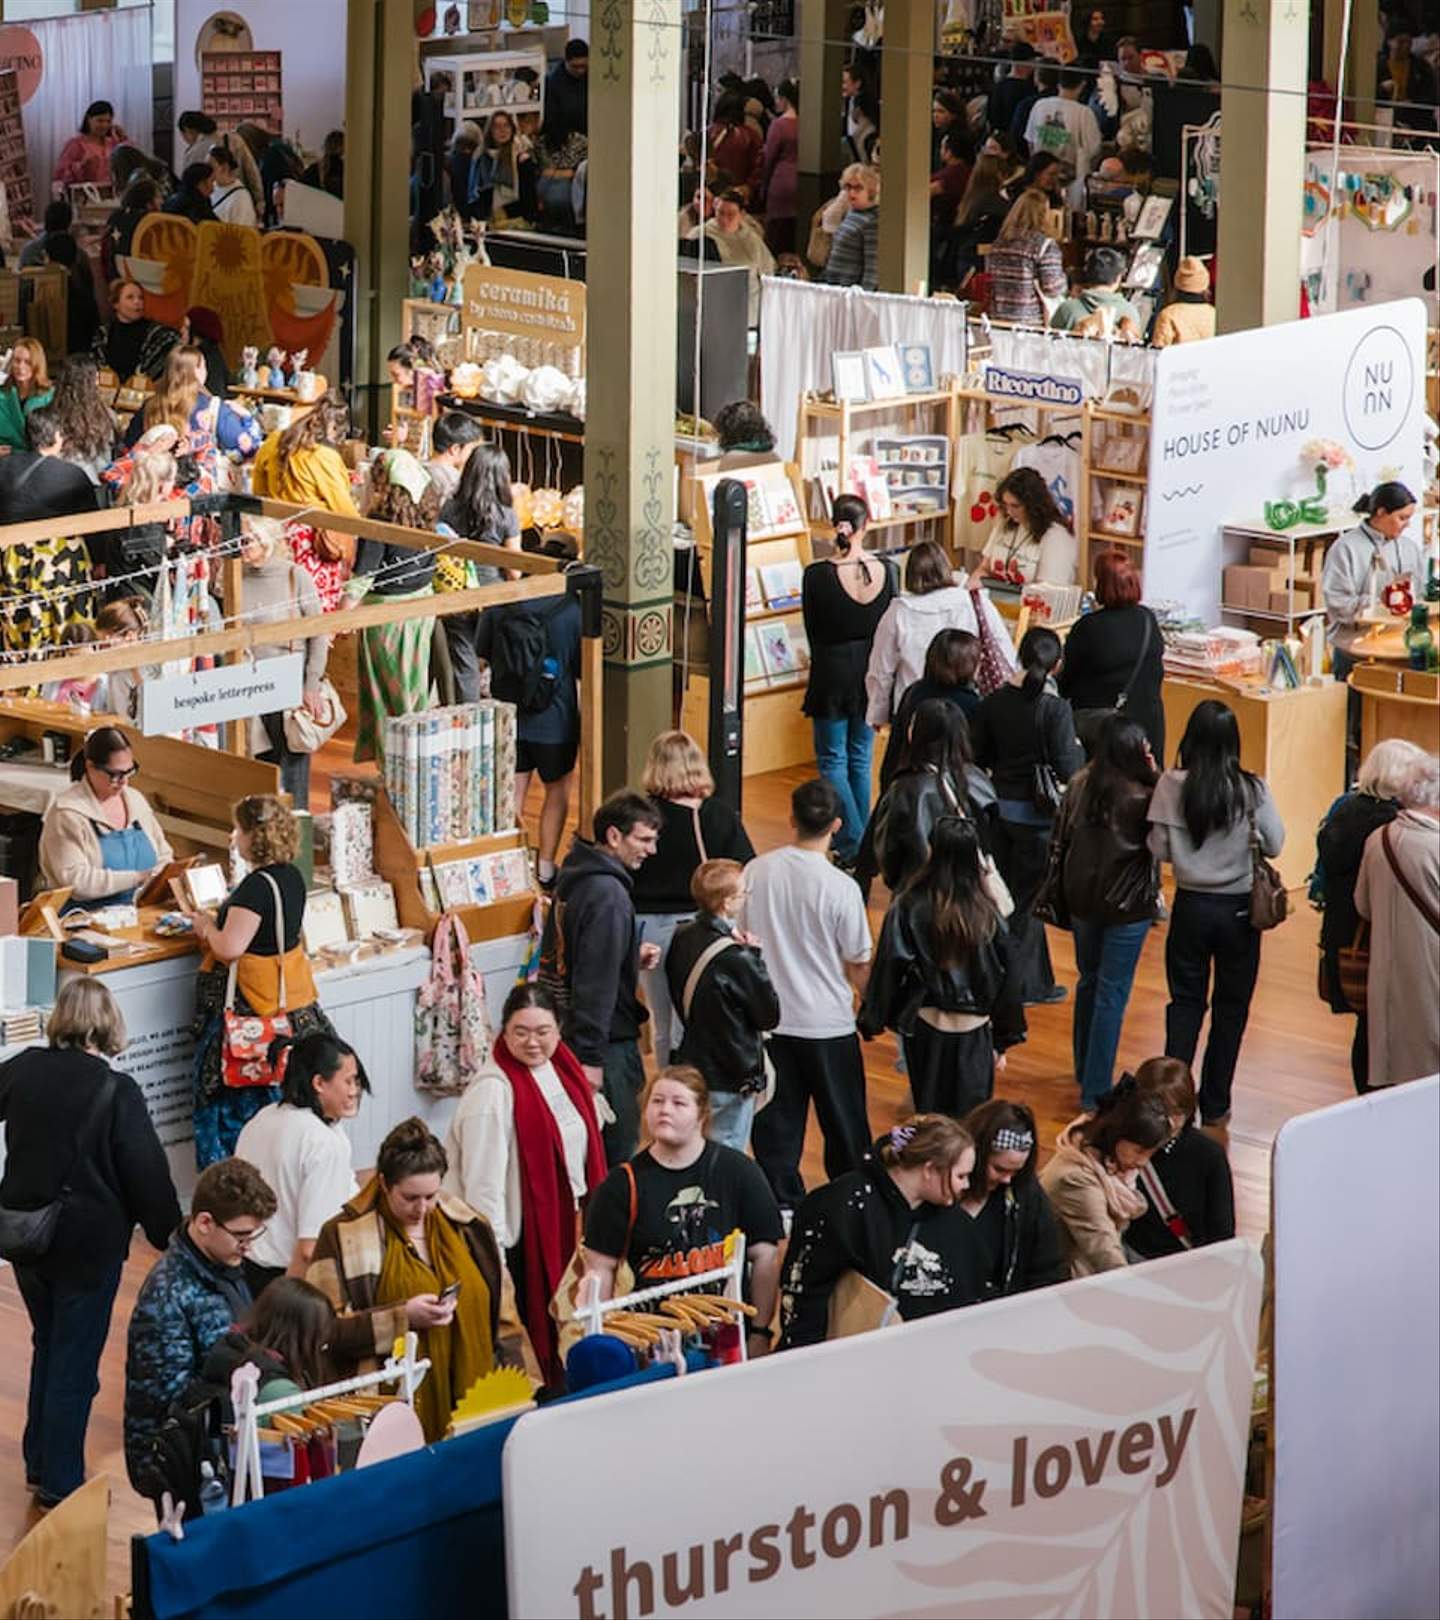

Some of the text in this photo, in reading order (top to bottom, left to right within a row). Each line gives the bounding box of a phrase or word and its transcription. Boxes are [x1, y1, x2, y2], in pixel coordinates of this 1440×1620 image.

[1164, 407, 1310, 461] HOUSE OF NUNU
[173, 682, 275, 709] bespoke letterpress
[573, 1408, 1199, 1620] thurston & lovey
